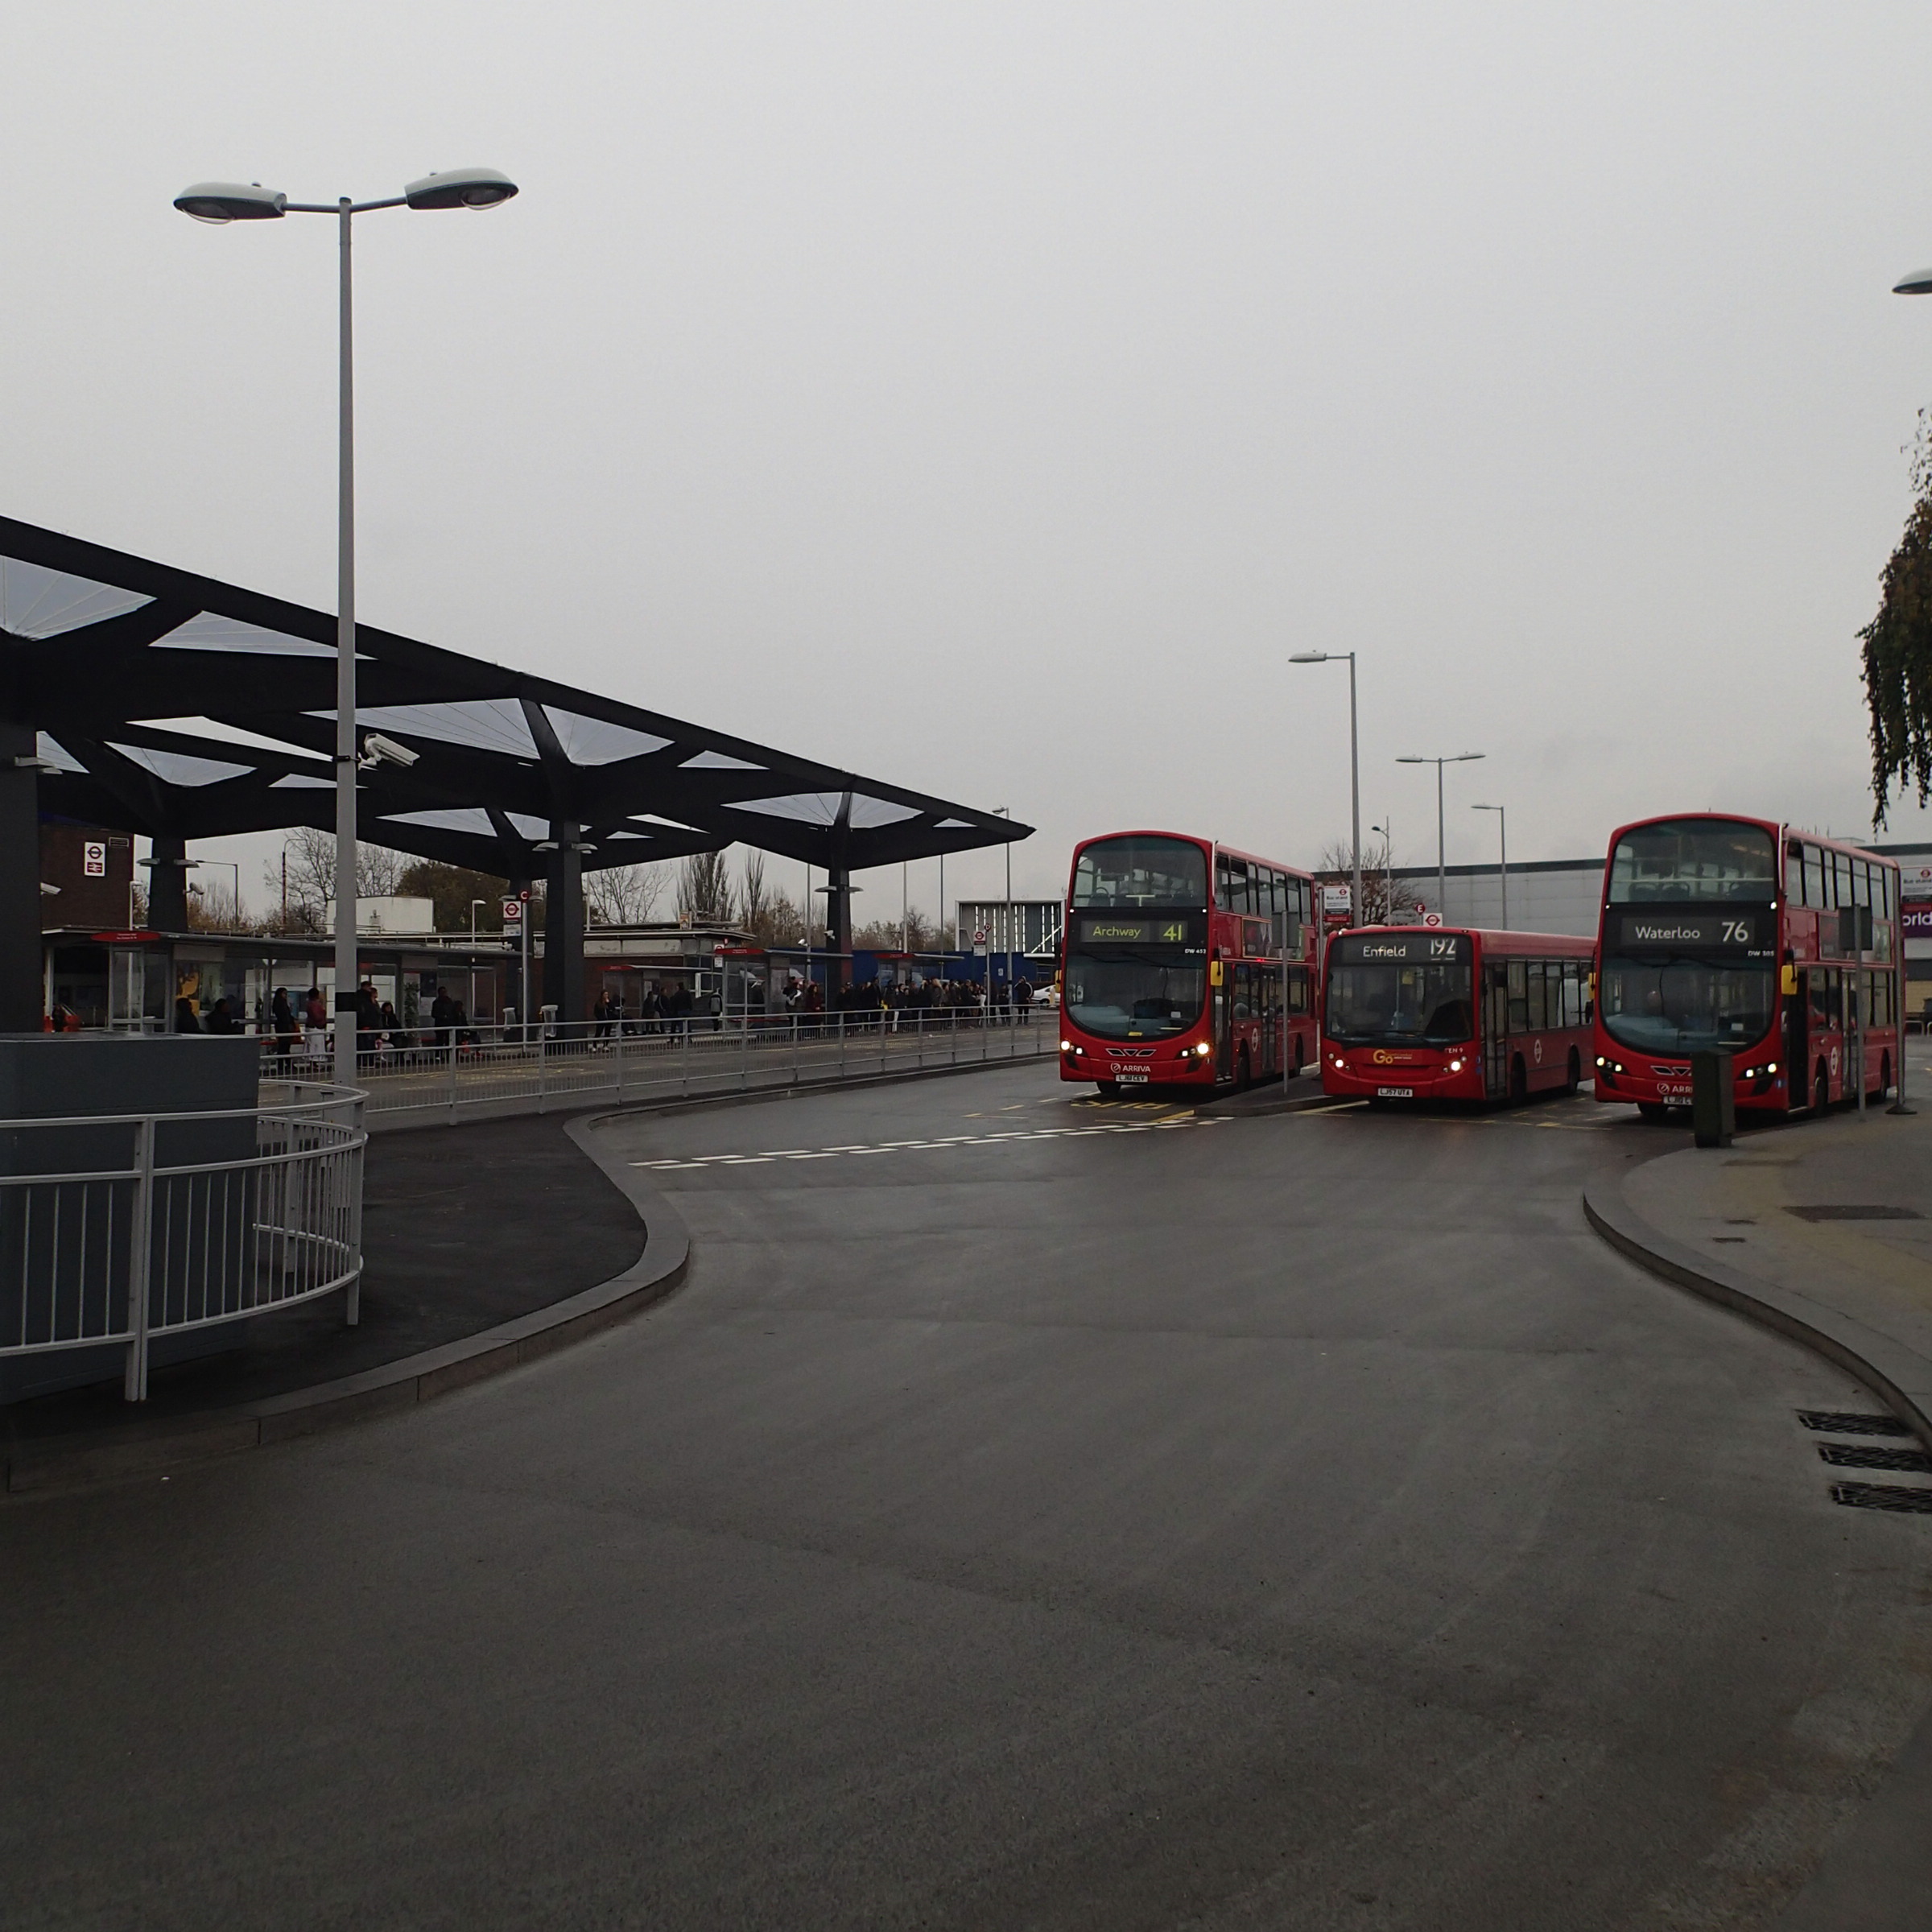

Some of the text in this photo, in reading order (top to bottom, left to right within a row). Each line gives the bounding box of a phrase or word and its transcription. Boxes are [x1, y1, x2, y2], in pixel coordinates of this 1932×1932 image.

[520, 890, 528, 900] C
[1417, 904, 1423, 913] E
[1902, 911, 1932, 927] orld
[1092, 924, 1183, 941] Archway 41
[1635, 921, 1748, 943] Waterloo 76
[1363, 938, 1456, 957] Enfield 192
[1373, 1049, 1393, 1064] Go
